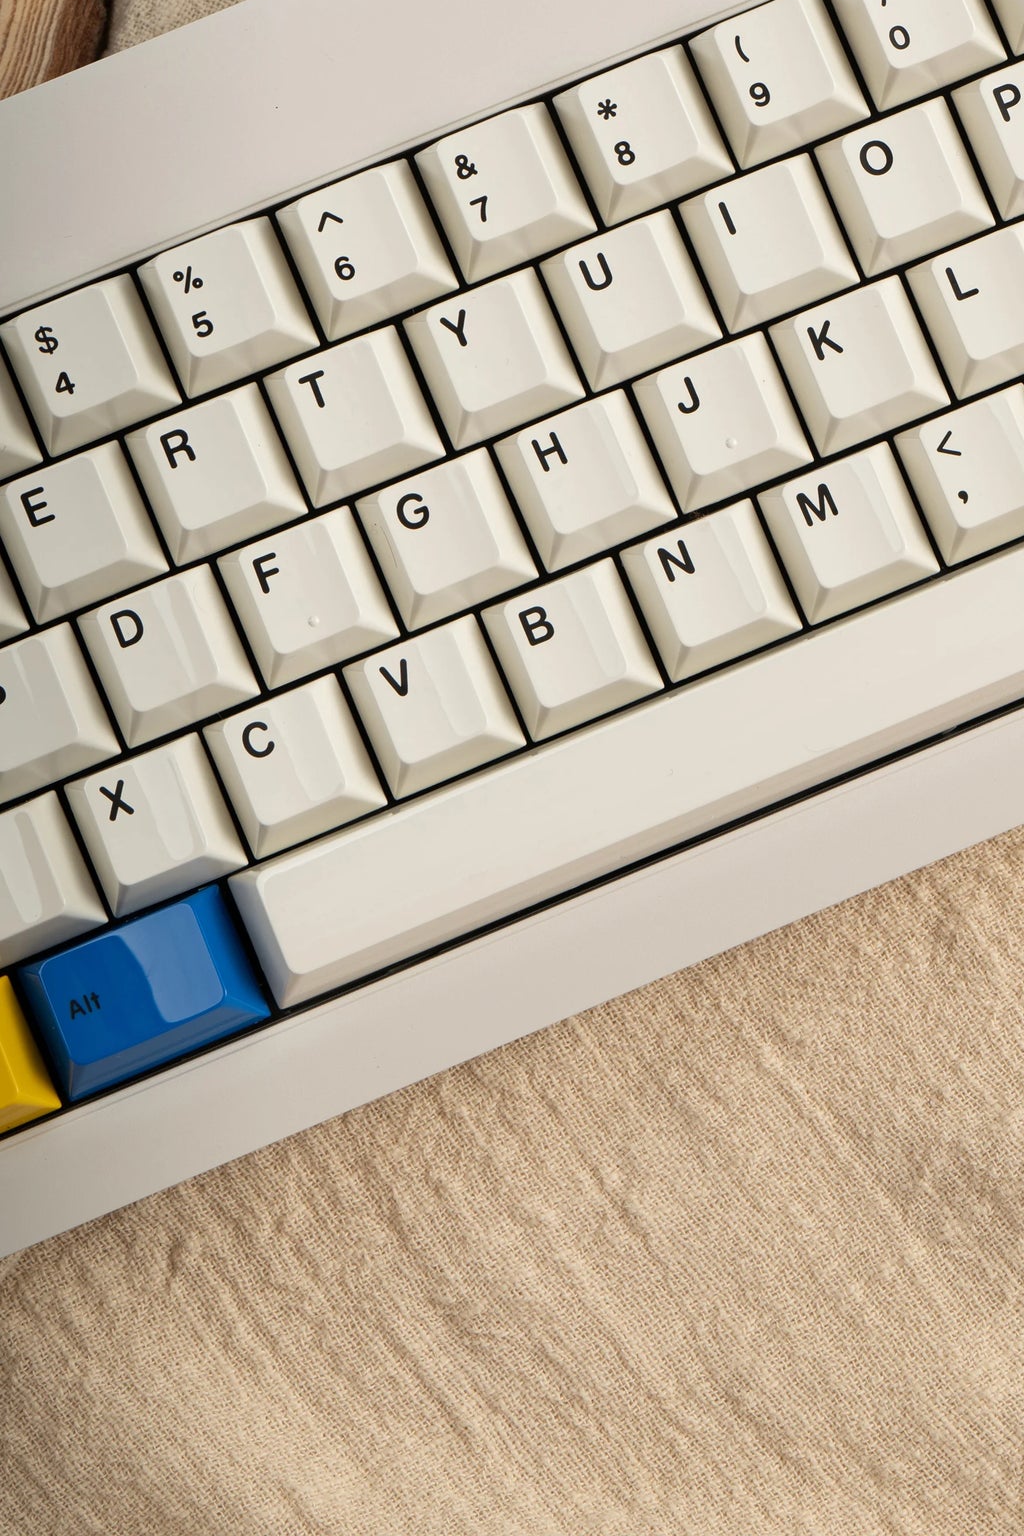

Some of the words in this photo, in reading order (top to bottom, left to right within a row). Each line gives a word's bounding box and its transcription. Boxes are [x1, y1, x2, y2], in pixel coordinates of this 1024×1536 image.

[735, 36, 749, 62] (
[749, 83, 770, 107] 9
[993, 84, 1021, 122] P
[455, 155, 478, 179] &
[614, 141, 635, 165] 8
[860, 141, 893, 175] O
[318, 212, 343, 232] ^
[470, 196, 487, 222] 7
[719, 202, 736, 235] I
[173, 266, 203, 294] %
[335, 256, 355, 280] 6
[579, 253, 612, 290] U
[946, 267, 979, 301] L
[35, 326, 58, 354] $
[192, 311, 213, 337] 5
[440, 309, 467, 346] Y
[807, 320, 843, 360] K
[56, 372, 75, 394] 4
[298, 370, 325, 408] T
[678, 377, 700, 414] J
[160, 429, 196, 469] R
[532, 432, 568, 472] H
[937, 431, 961, 456] <
[21, 487, 55, 527] E
[397, 493, 429, 529] G
[795, 482, 838, 526] M
[253, 553, 279, 594] F
[656, 538, 696, 582] N
[110, 610, 143, 648] D
[519, 606, 554, 646] B
[379, 659, 408, 696] V
[242, 722, 274, 758] C
[99, 780, 134, 821] X
[70, 992, 100, 1020] Alt
